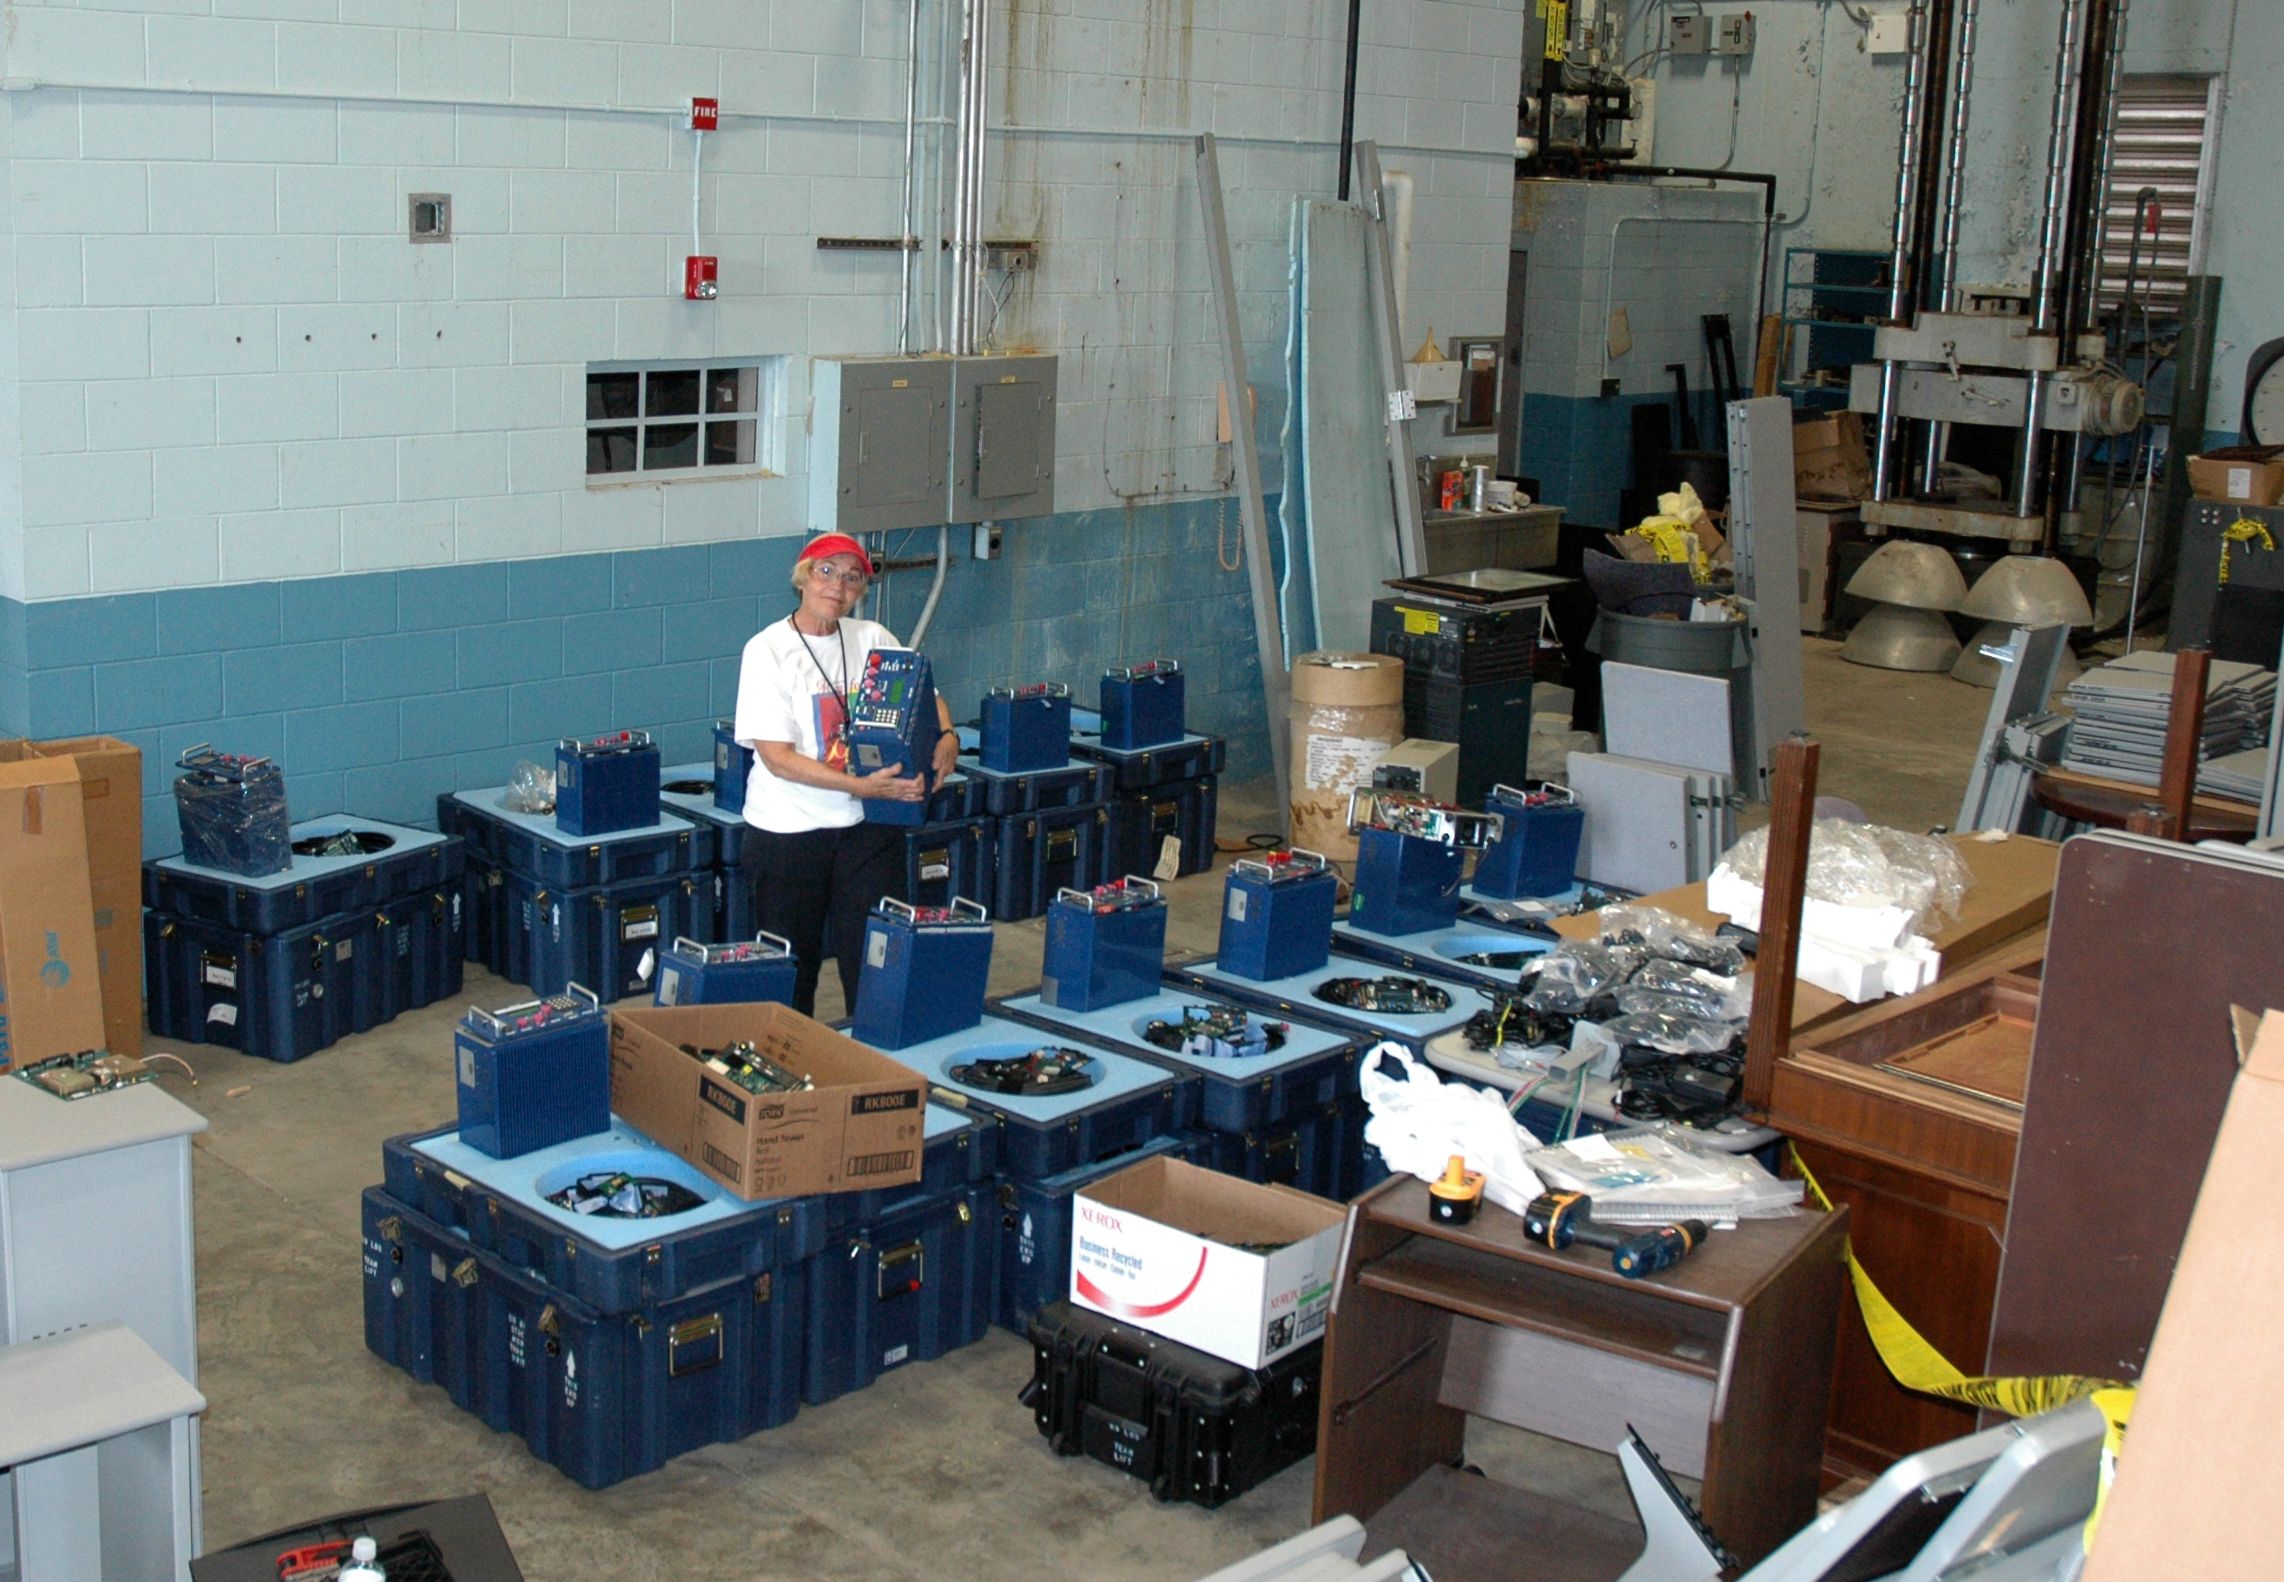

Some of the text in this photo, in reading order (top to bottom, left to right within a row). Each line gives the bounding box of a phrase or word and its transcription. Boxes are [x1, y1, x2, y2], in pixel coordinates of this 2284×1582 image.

[694, 106, 717, 118] FIRE
[864, 1094, 906, 1110] RK800E
[756, 1133, 805, 1146] Hand Towel
[1081, 1206, 1124, 1233] XEROX
[1079, 1235, 1143, 1271] Business Recycled
